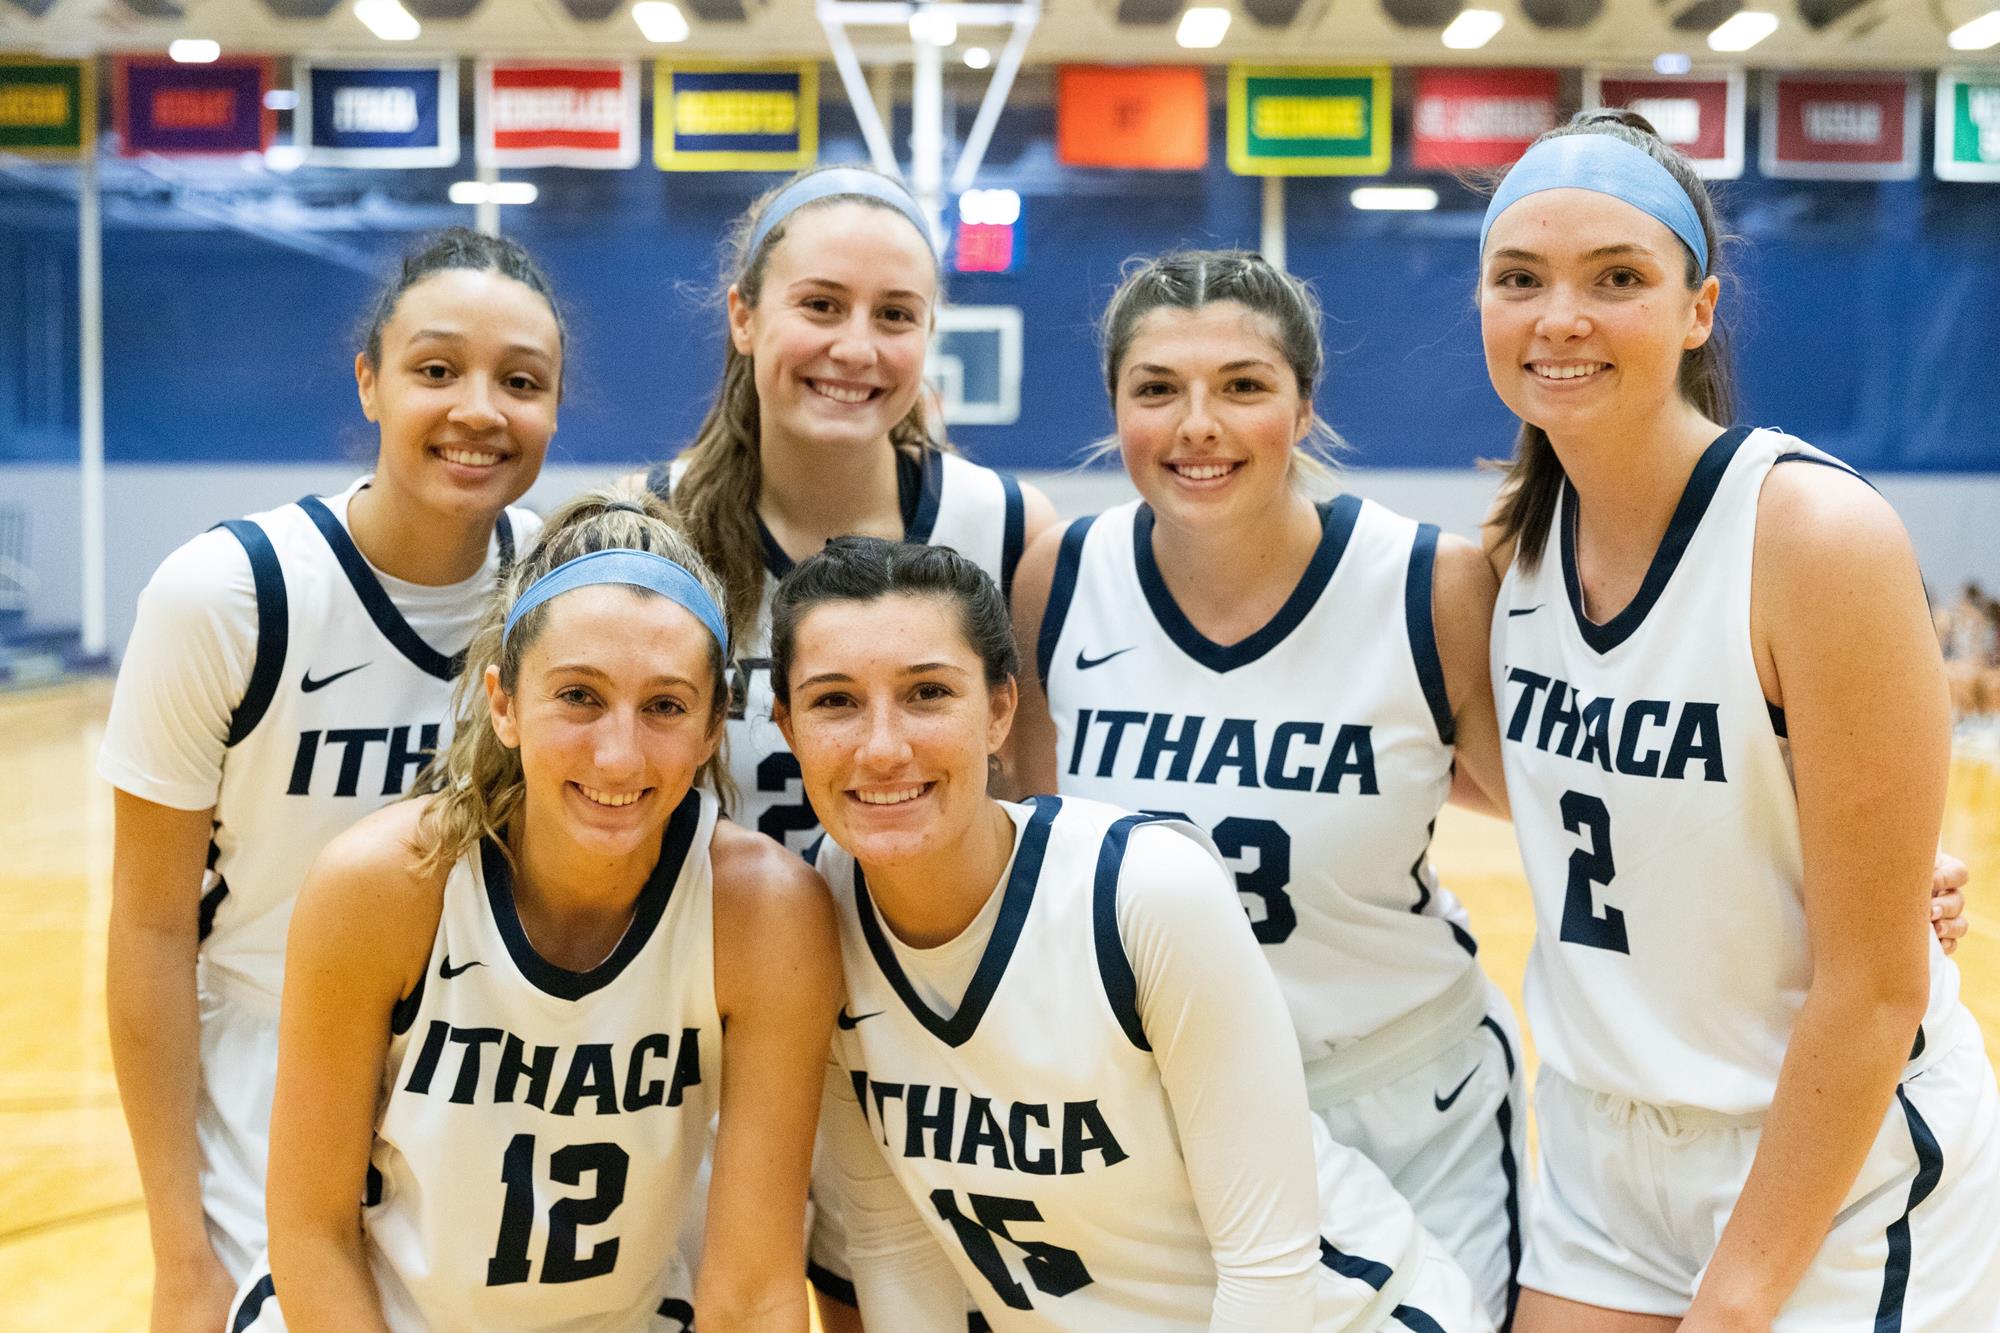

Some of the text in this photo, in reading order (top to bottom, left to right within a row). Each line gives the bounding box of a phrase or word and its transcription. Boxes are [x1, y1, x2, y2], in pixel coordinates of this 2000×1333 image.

[286, 723, 441, 797] ITH
[1068, 709, 1380, 795] ITHACA
[1504, 665, 1728, 783] THACA
[1559, 789, 1631, 955] 2
[403, 1020, 702, 1117] ITHACA
[486, 1133, 630, 1287] 12
[929, 1188, 1095, 1311] 15
